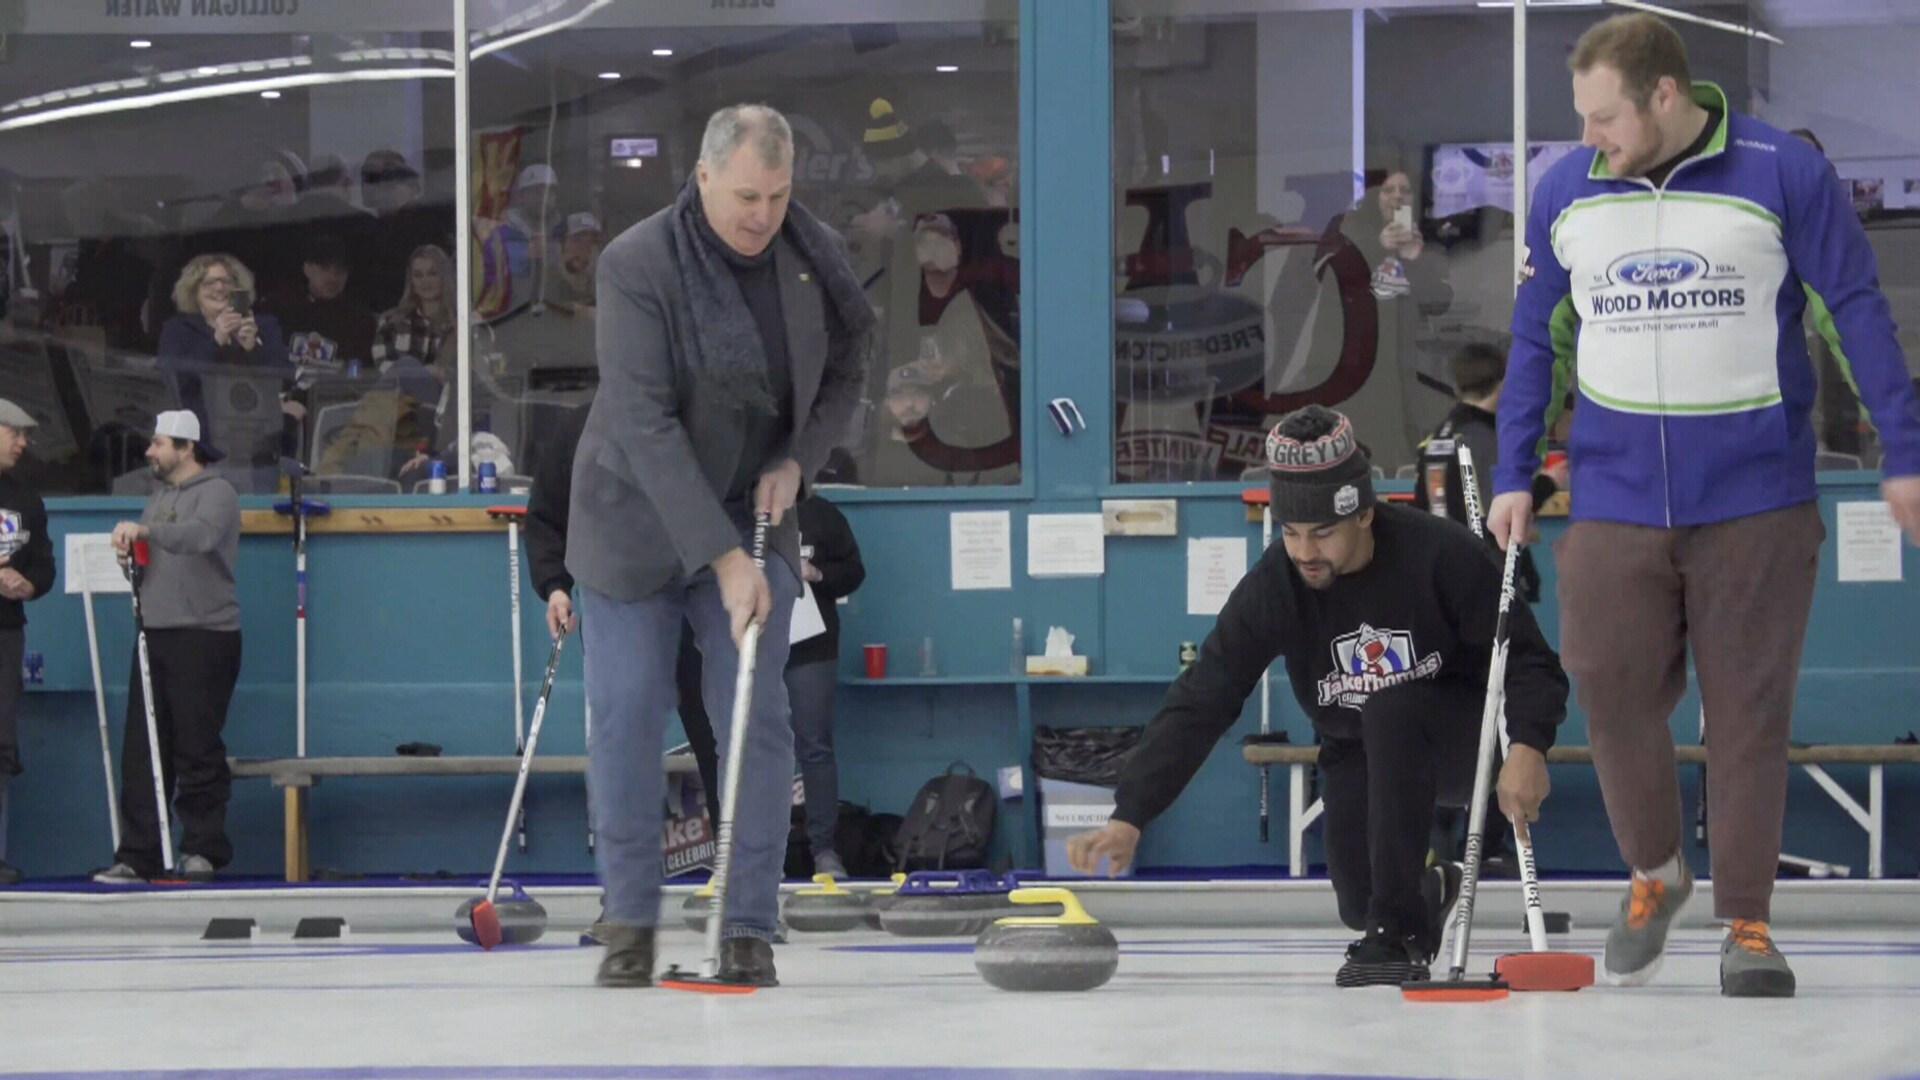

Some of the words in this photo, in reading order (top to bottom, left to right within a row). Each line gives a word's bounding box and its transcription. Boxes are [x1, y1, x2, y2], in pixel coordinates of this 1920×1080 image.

[1631, 261, 1683, 283] Ford
[1591, 293, 1642, 316] WOOD
[1647, 287, 1746, 311] MOTORS
[1273, 441, 1328, 466] GREY
[666, 839, 717, 871] CELEBRIT
